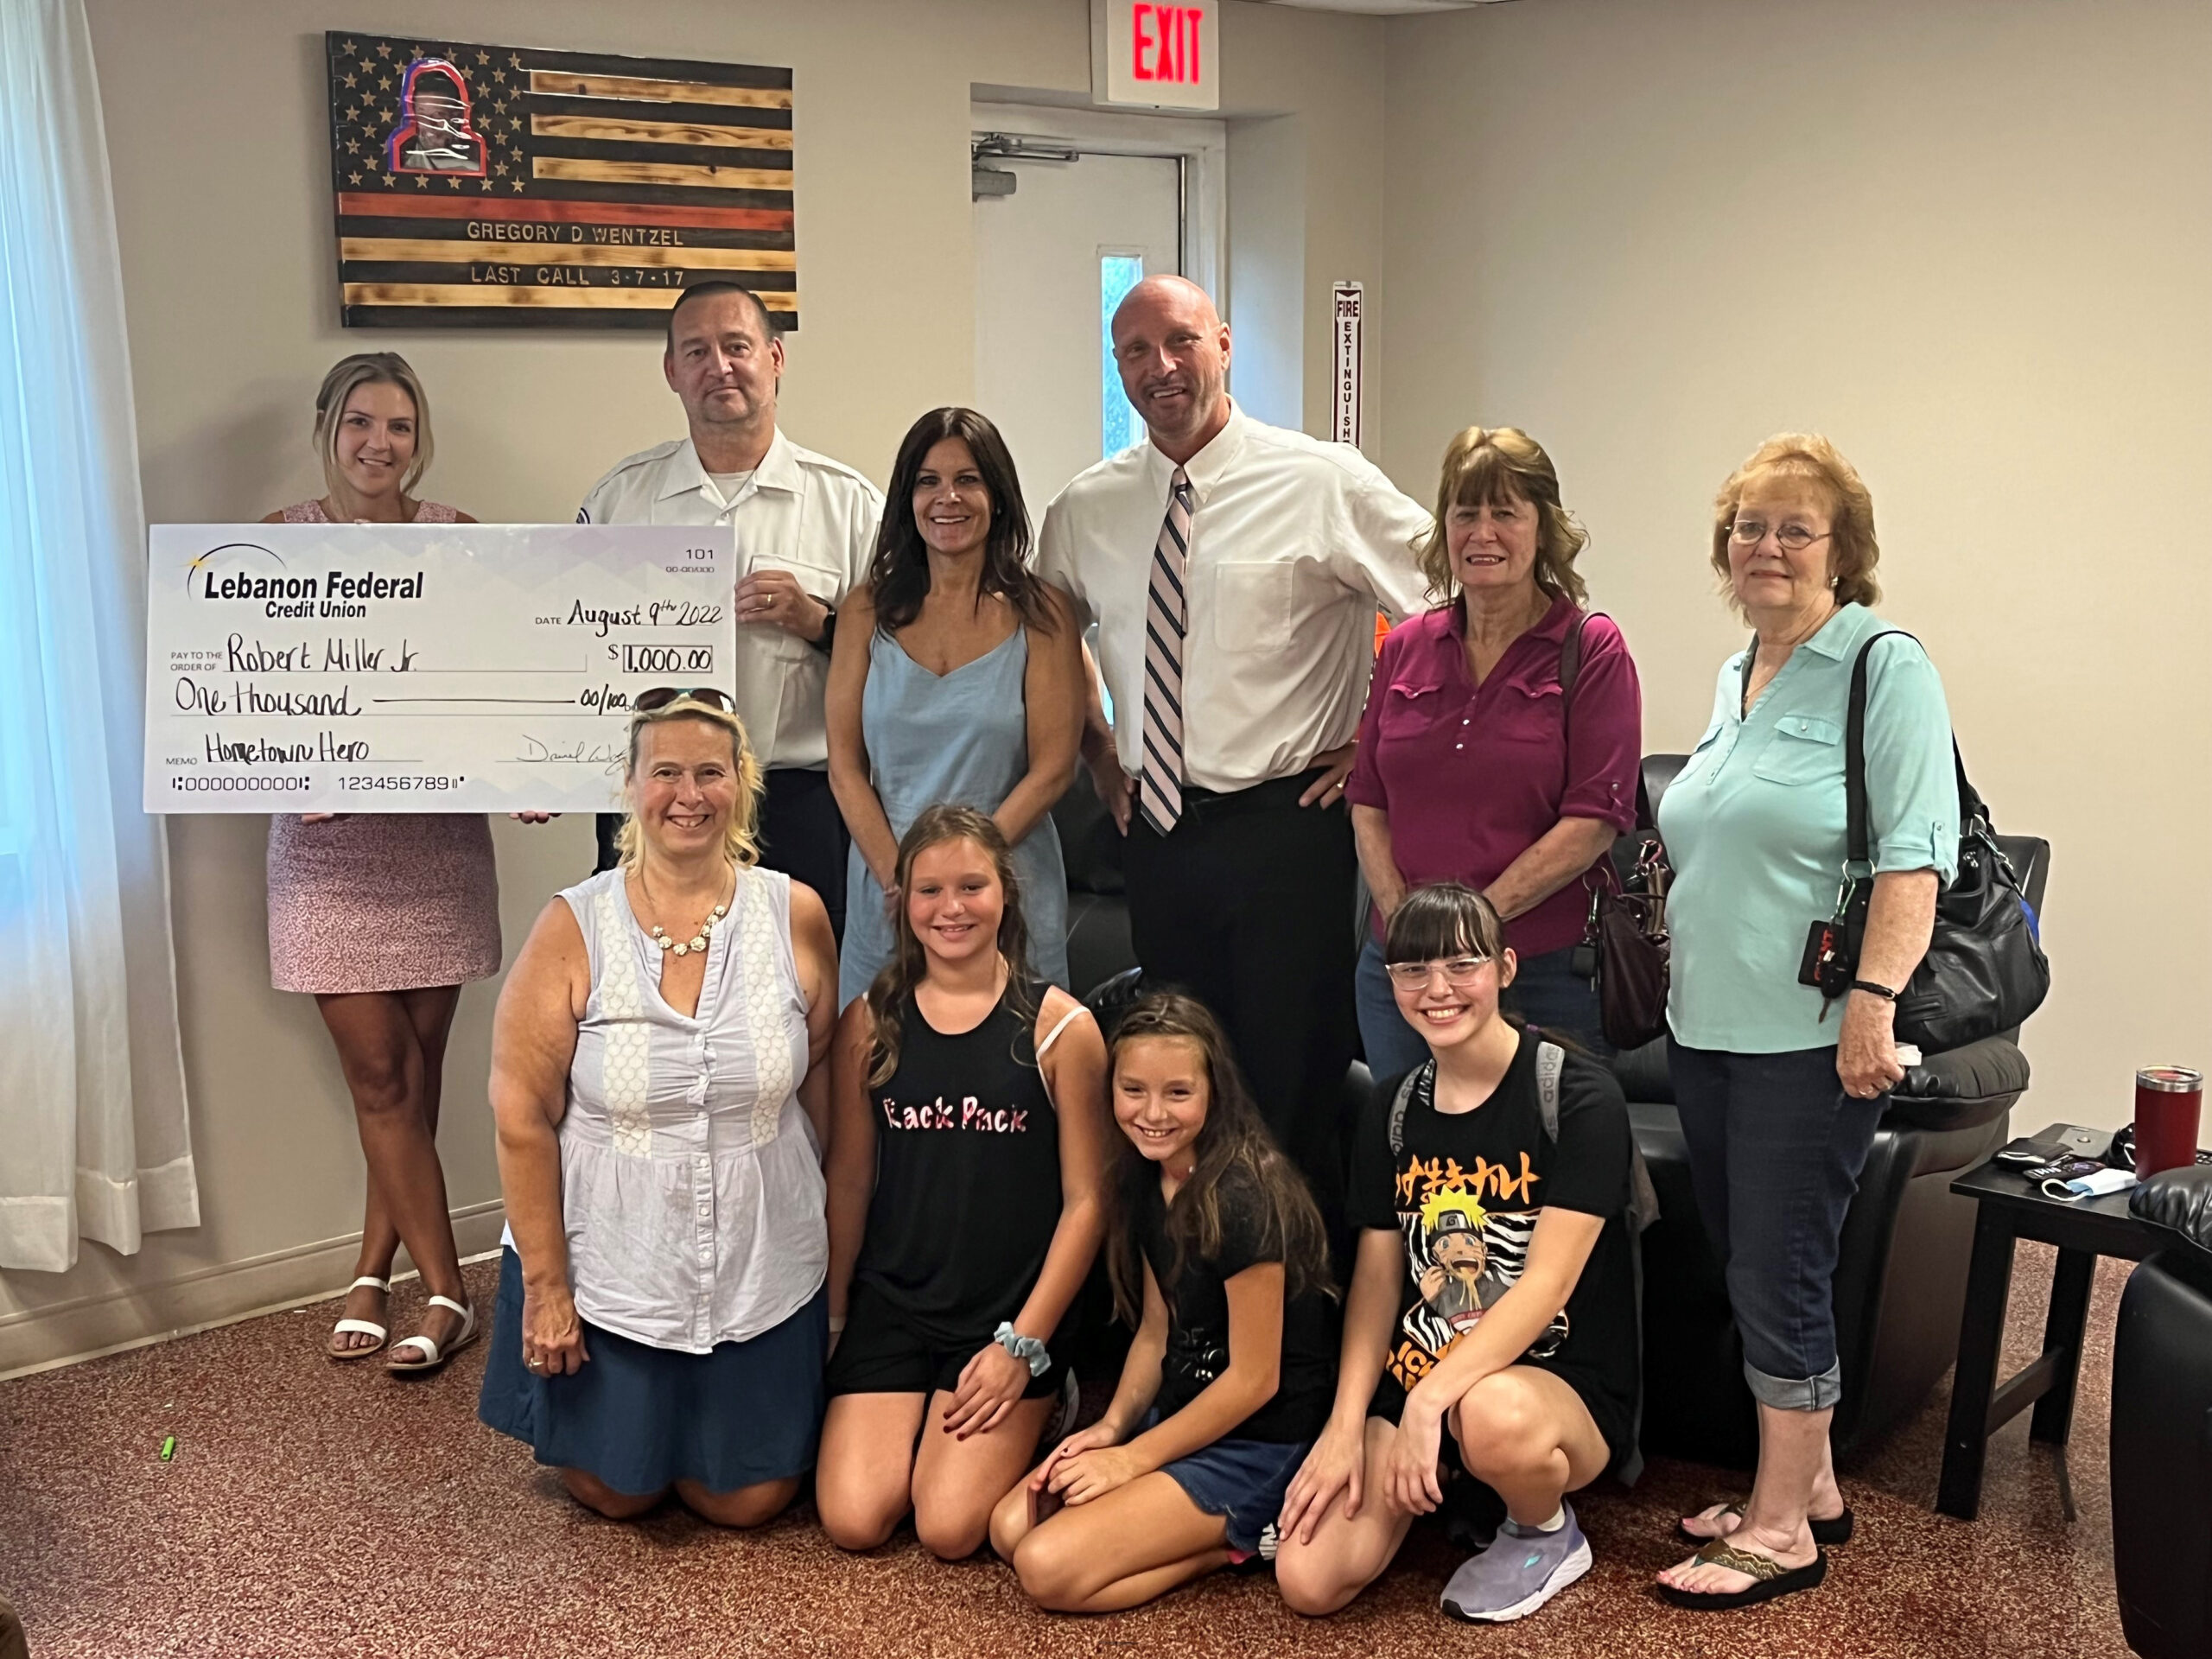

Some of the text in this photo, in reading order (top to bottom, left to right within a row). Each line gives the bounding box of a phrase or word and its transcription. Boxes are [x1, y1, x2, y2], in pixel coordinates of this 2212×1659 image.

[1132, 3, 1203, 84] EXIT
[467, 221, 560, 242] GREGORY
[592, 227, 684, 245] WENTZEL
[471, 266, 520, 283] LAST
[537, 267, 589, 286] CALL
[1337, 301, 1359, 317] FIRE
[1343, 321, 1352, 442] EXTINGUISH
[685, 549, 714, 560] 101
[205, 572, 423, 599] Lebanon Federal
[265, 601, 366, 618] Credit Union
[535, 616, 562, 625] DATE
[567, 599, 642, 638] August
[676, 601, 723, 626] 2022
[227, 632, 311, 672] Robert
[324, 638, 385, 672] Miller
[607, 644, 619, 661] $
[626, 646, 711, 673] 1,000.00
[175, 677, 226, 715] One
[206, 731, 370, 765] Hometown Hero
